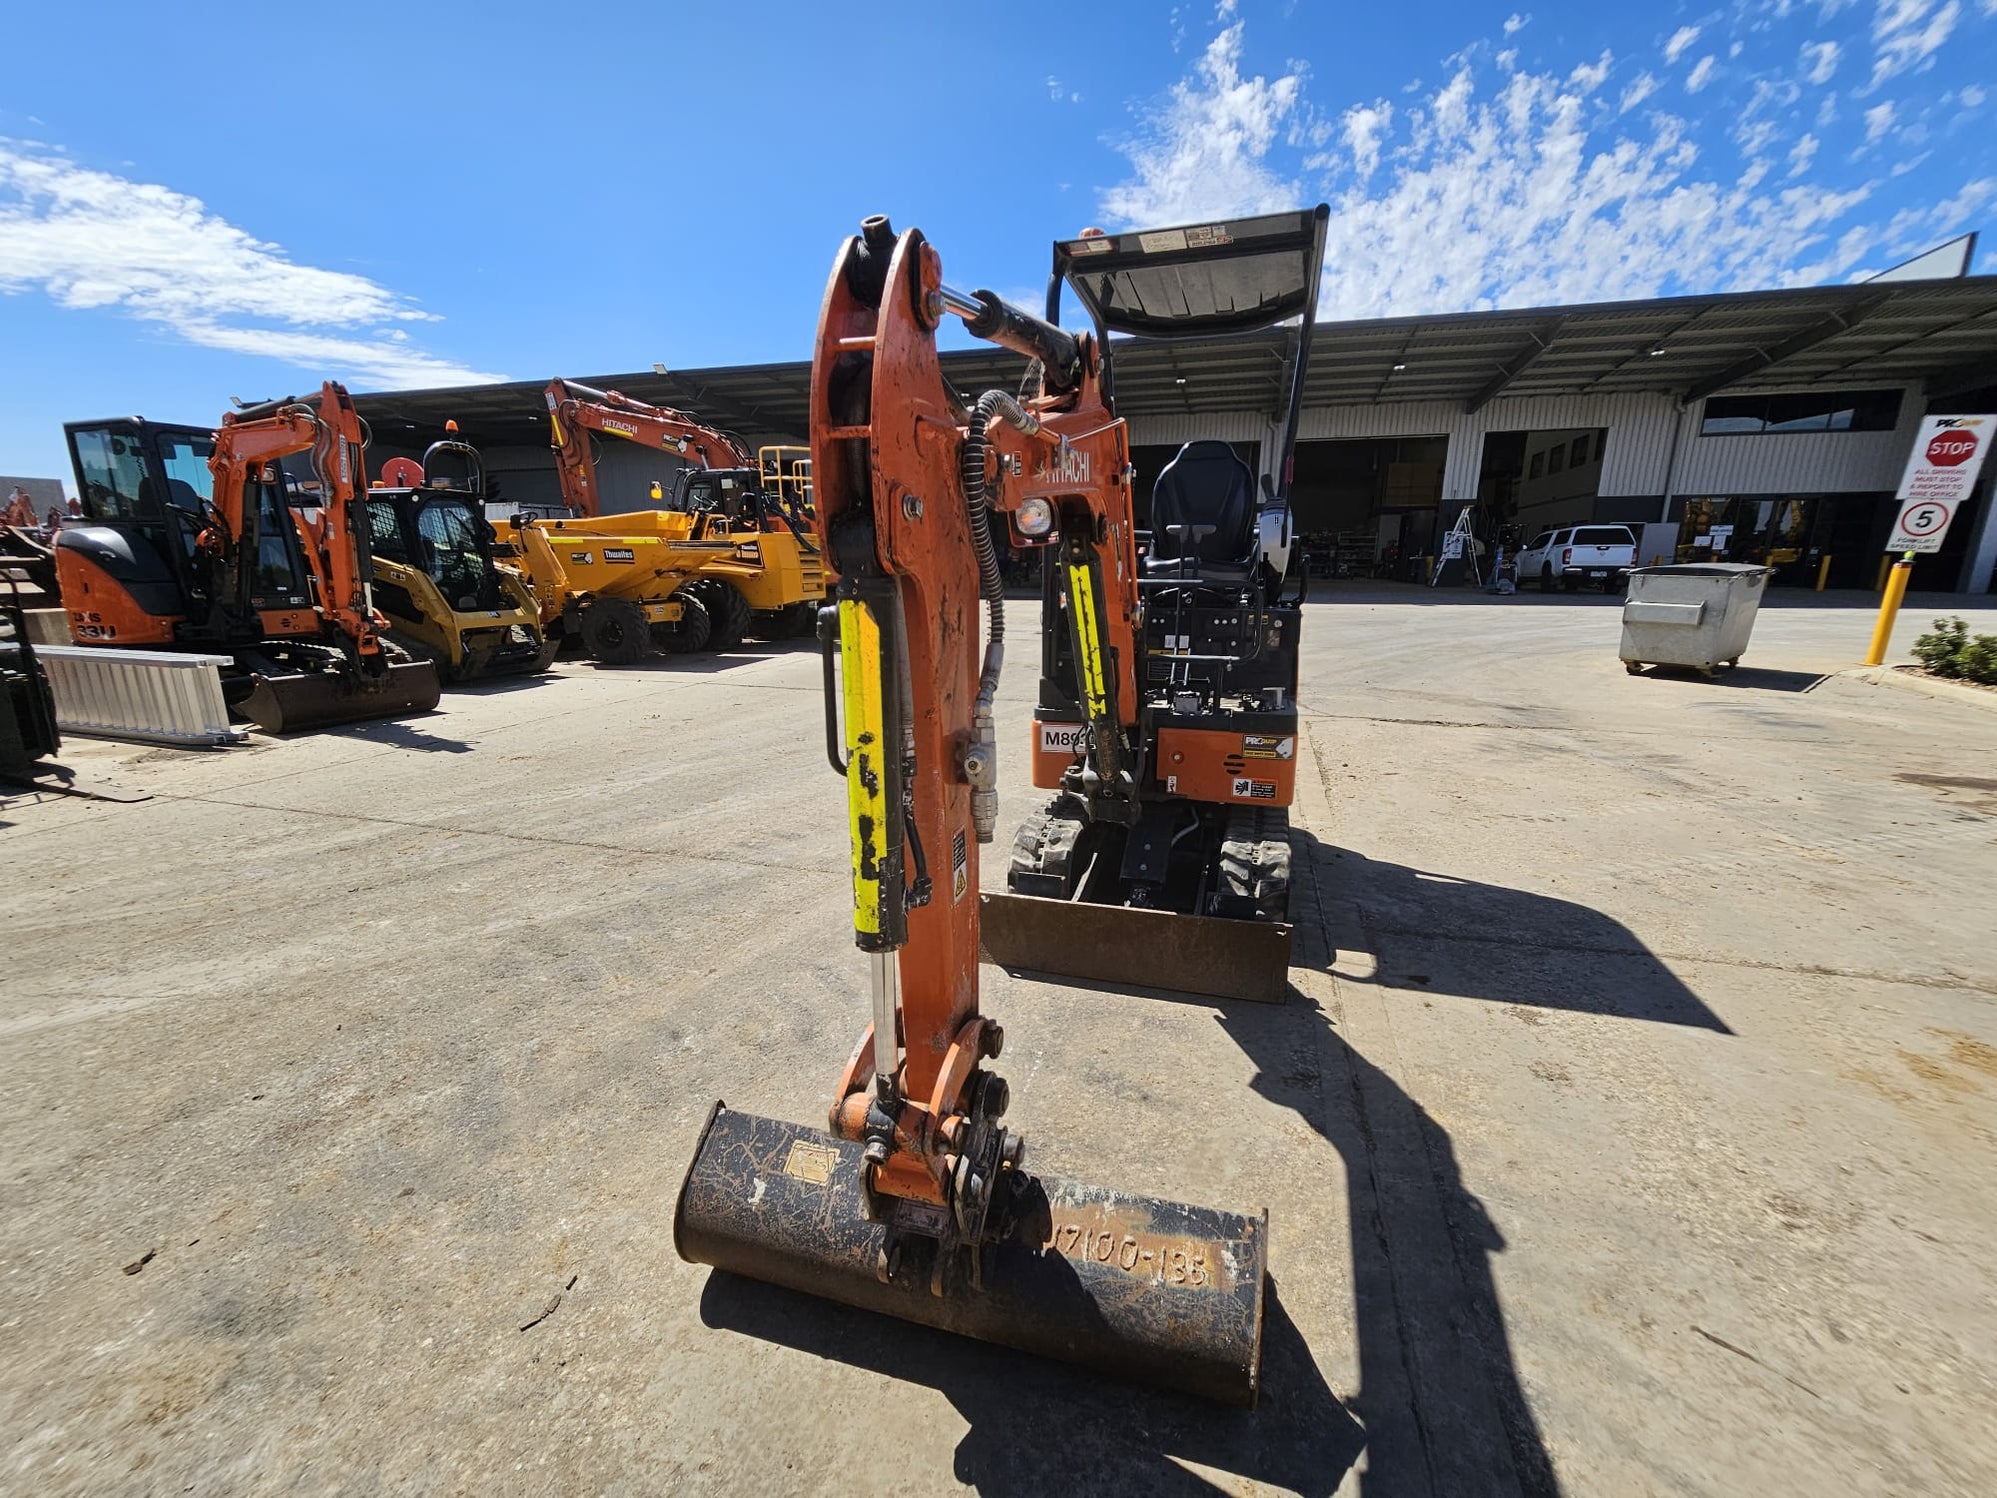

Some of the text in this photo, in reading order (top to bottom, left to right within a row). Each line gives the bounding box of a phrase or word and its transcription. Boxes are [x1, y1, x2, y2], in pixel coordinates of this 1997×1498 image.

[602, 418, 638, 434] HITACHI
[1929, 441, 1975, 455] STOP
[1915, 510, 1935, 528] 5
